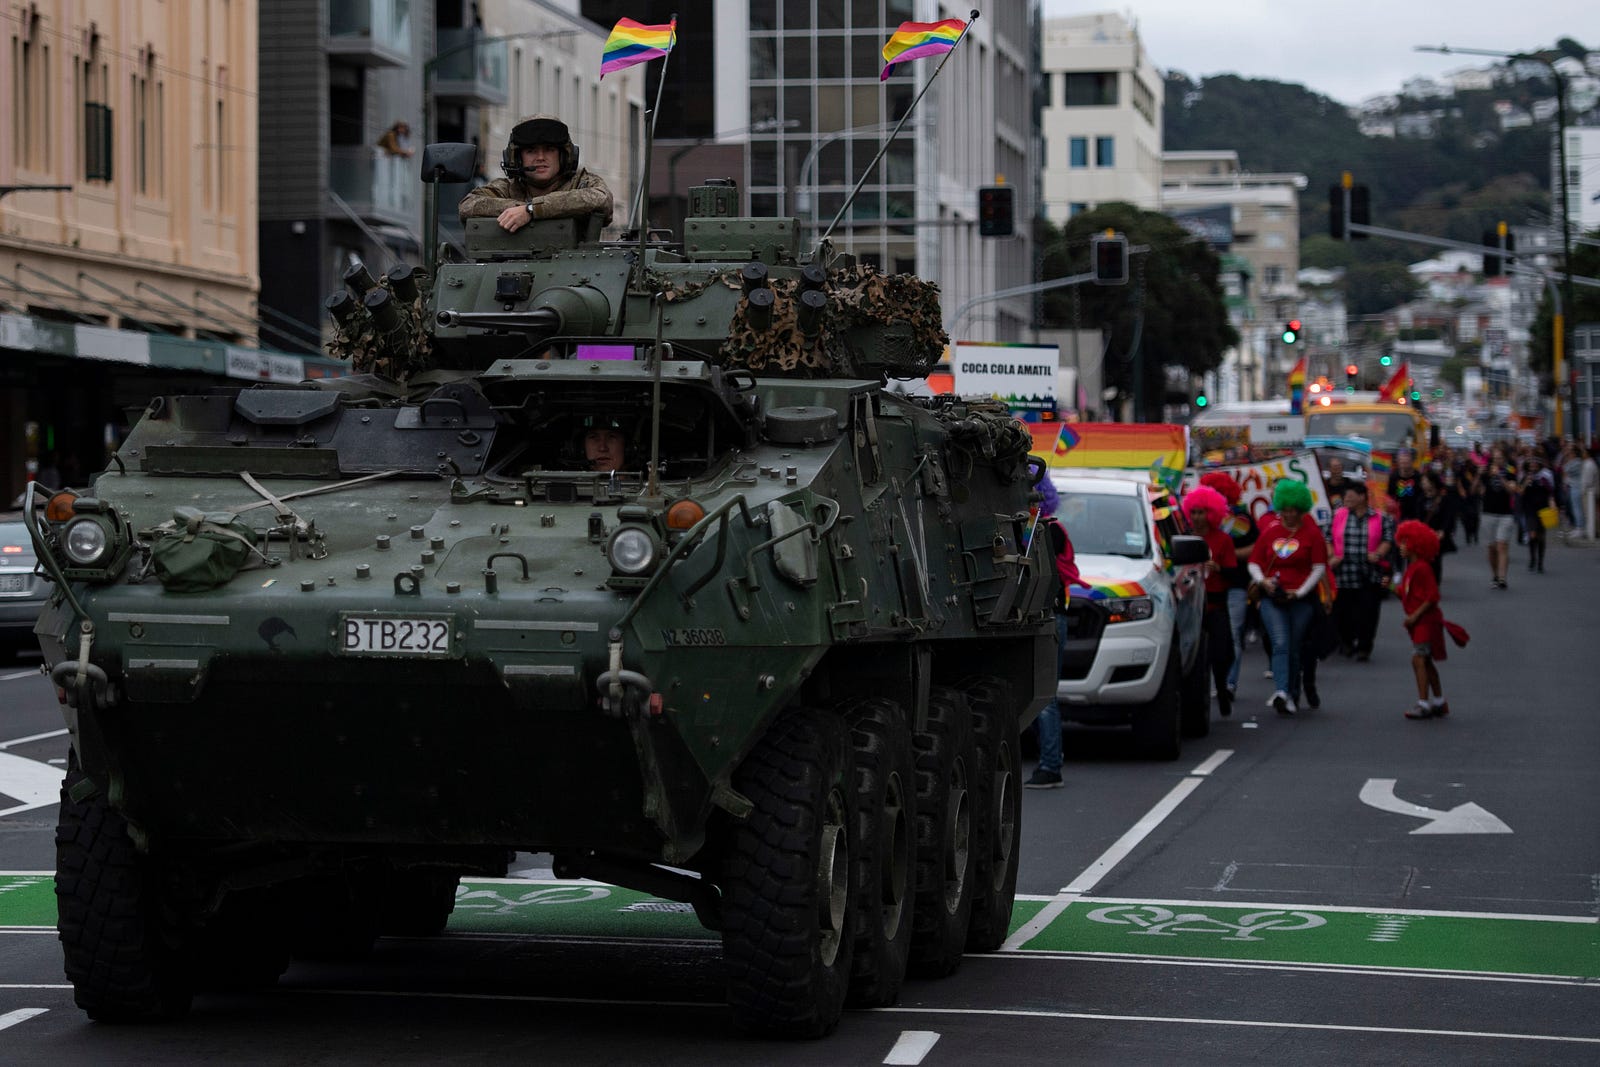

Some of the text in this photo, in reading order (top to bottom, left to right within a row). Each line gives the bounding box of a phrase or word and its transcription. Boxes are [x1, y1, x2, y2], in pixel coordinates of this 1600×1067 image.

[962, 362, 1051, 376] COCA COLA AMATIL
[344, 620, 449, 651] BTB232
[661, 629, 725, 645] NZ 36038
